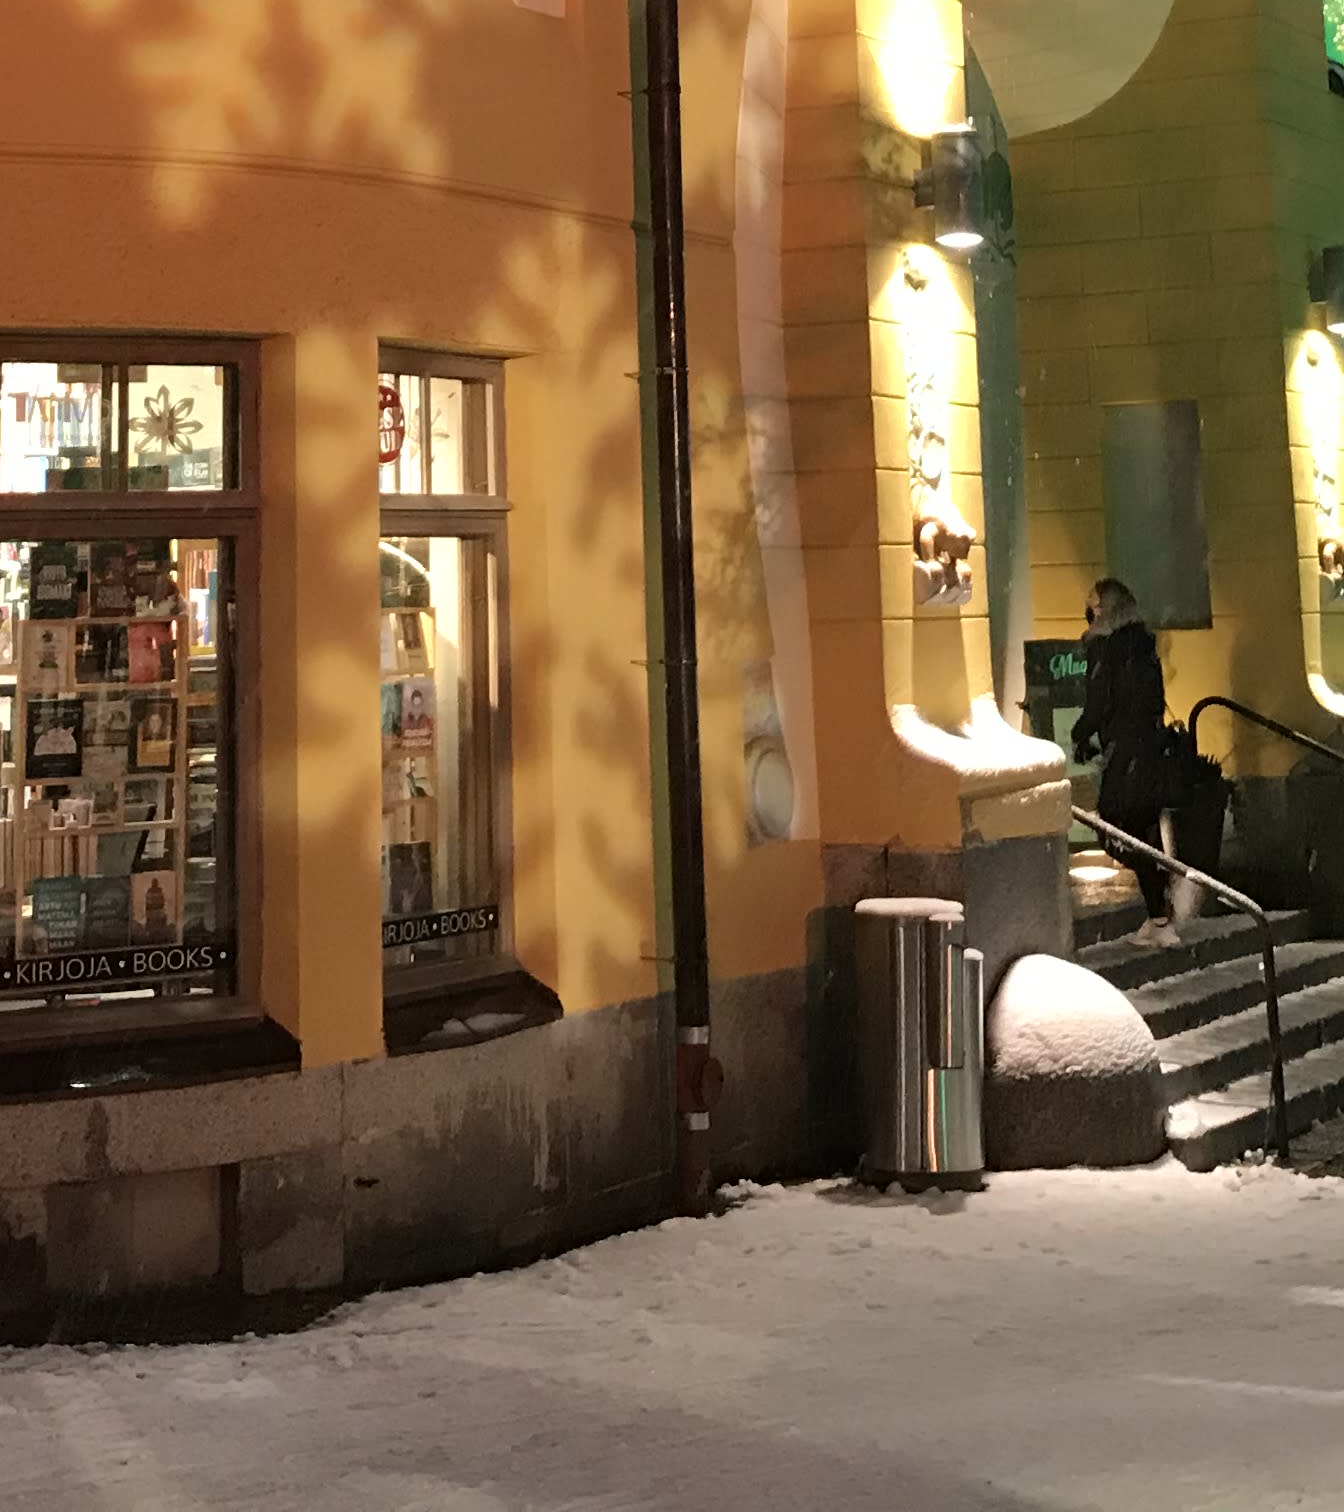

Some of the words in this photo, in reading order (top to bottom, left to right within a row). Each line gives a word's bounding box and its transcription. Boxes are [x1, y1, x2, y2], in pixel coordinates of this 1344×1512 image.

[440, 908, 486, 935] BOOKS
[16, 955, 112, 985] KIRJOJA
[132, 946, 214, 975] BOOKS
